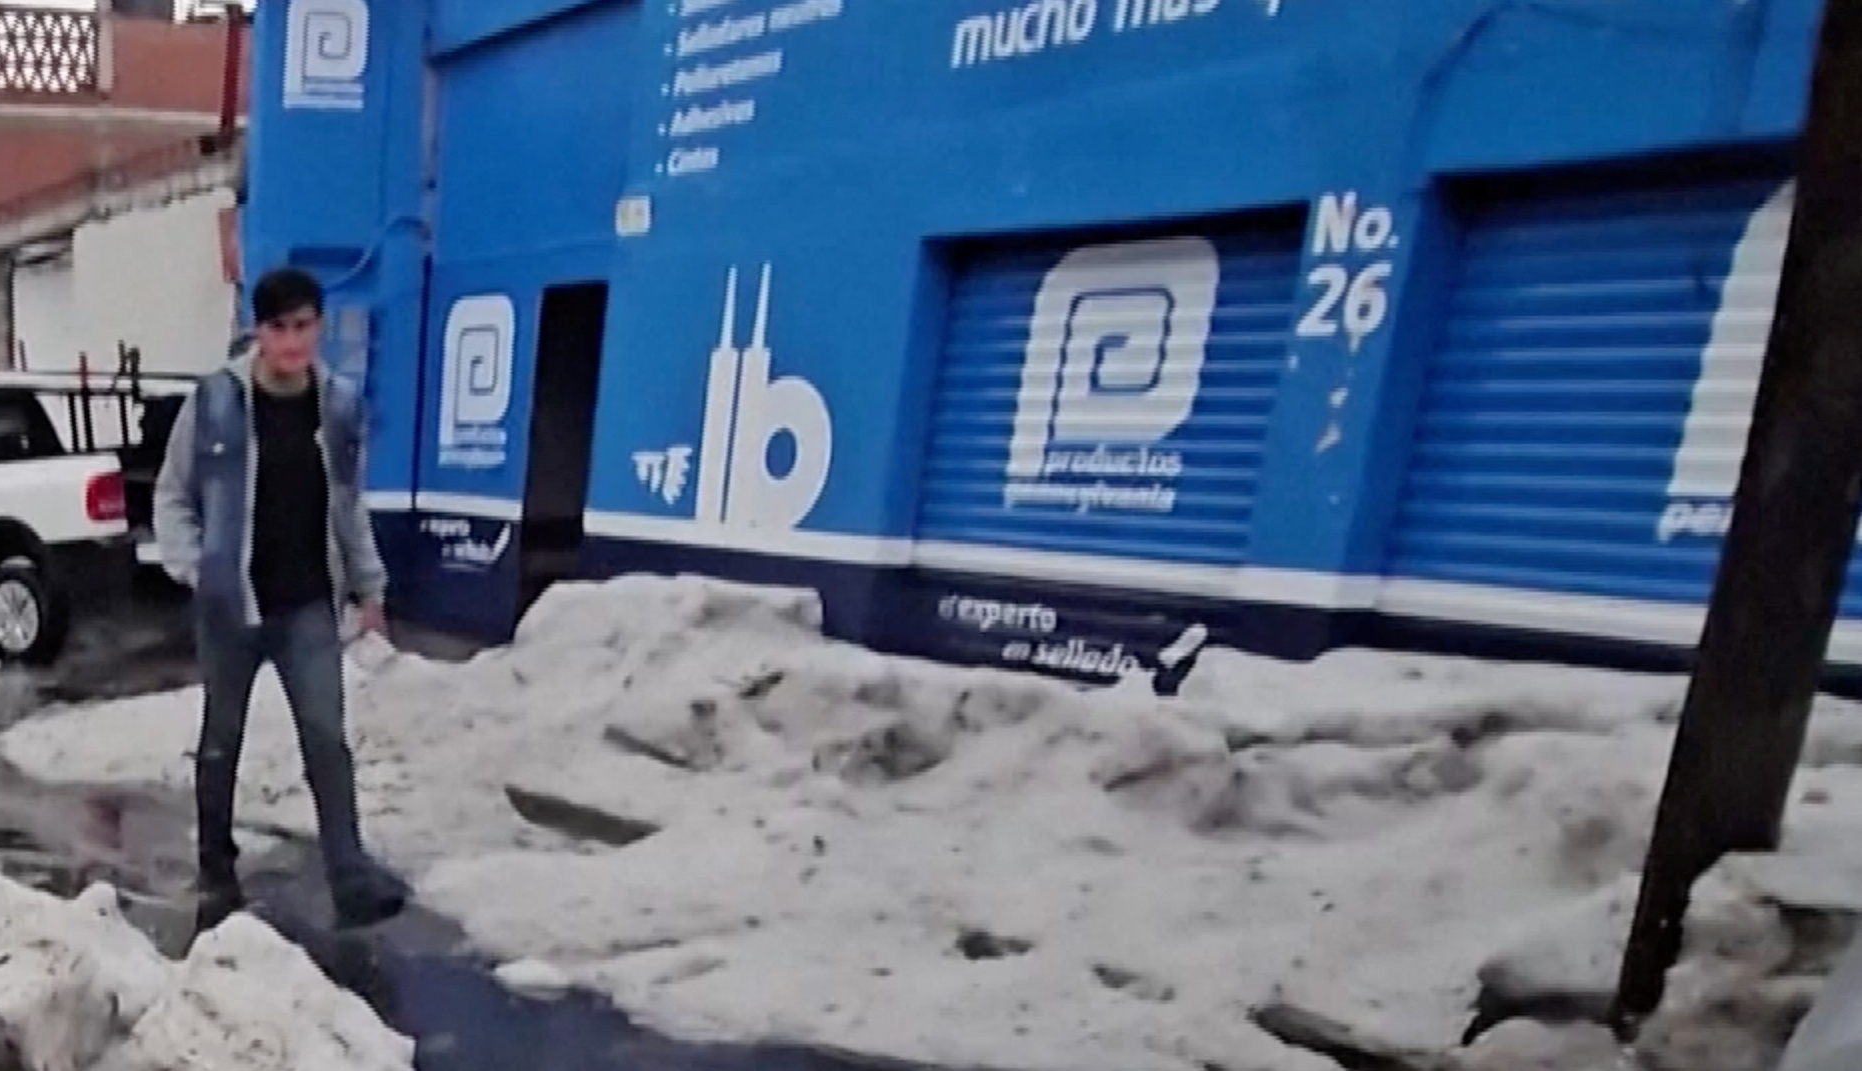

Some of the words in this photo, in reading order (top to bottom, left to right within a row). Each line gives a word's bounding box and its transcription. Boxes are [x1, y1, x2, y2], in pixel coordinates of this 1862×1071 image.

[950, 0, 1098, 68] mucho
[1312, 190, 1400, 255] No.
[1295, 260, 1393, 338] 26
[1044, 444, 1184, 478] productos
[957, 597, 1058, 633] experto
[1031, 638, 1138, 677] sellado
